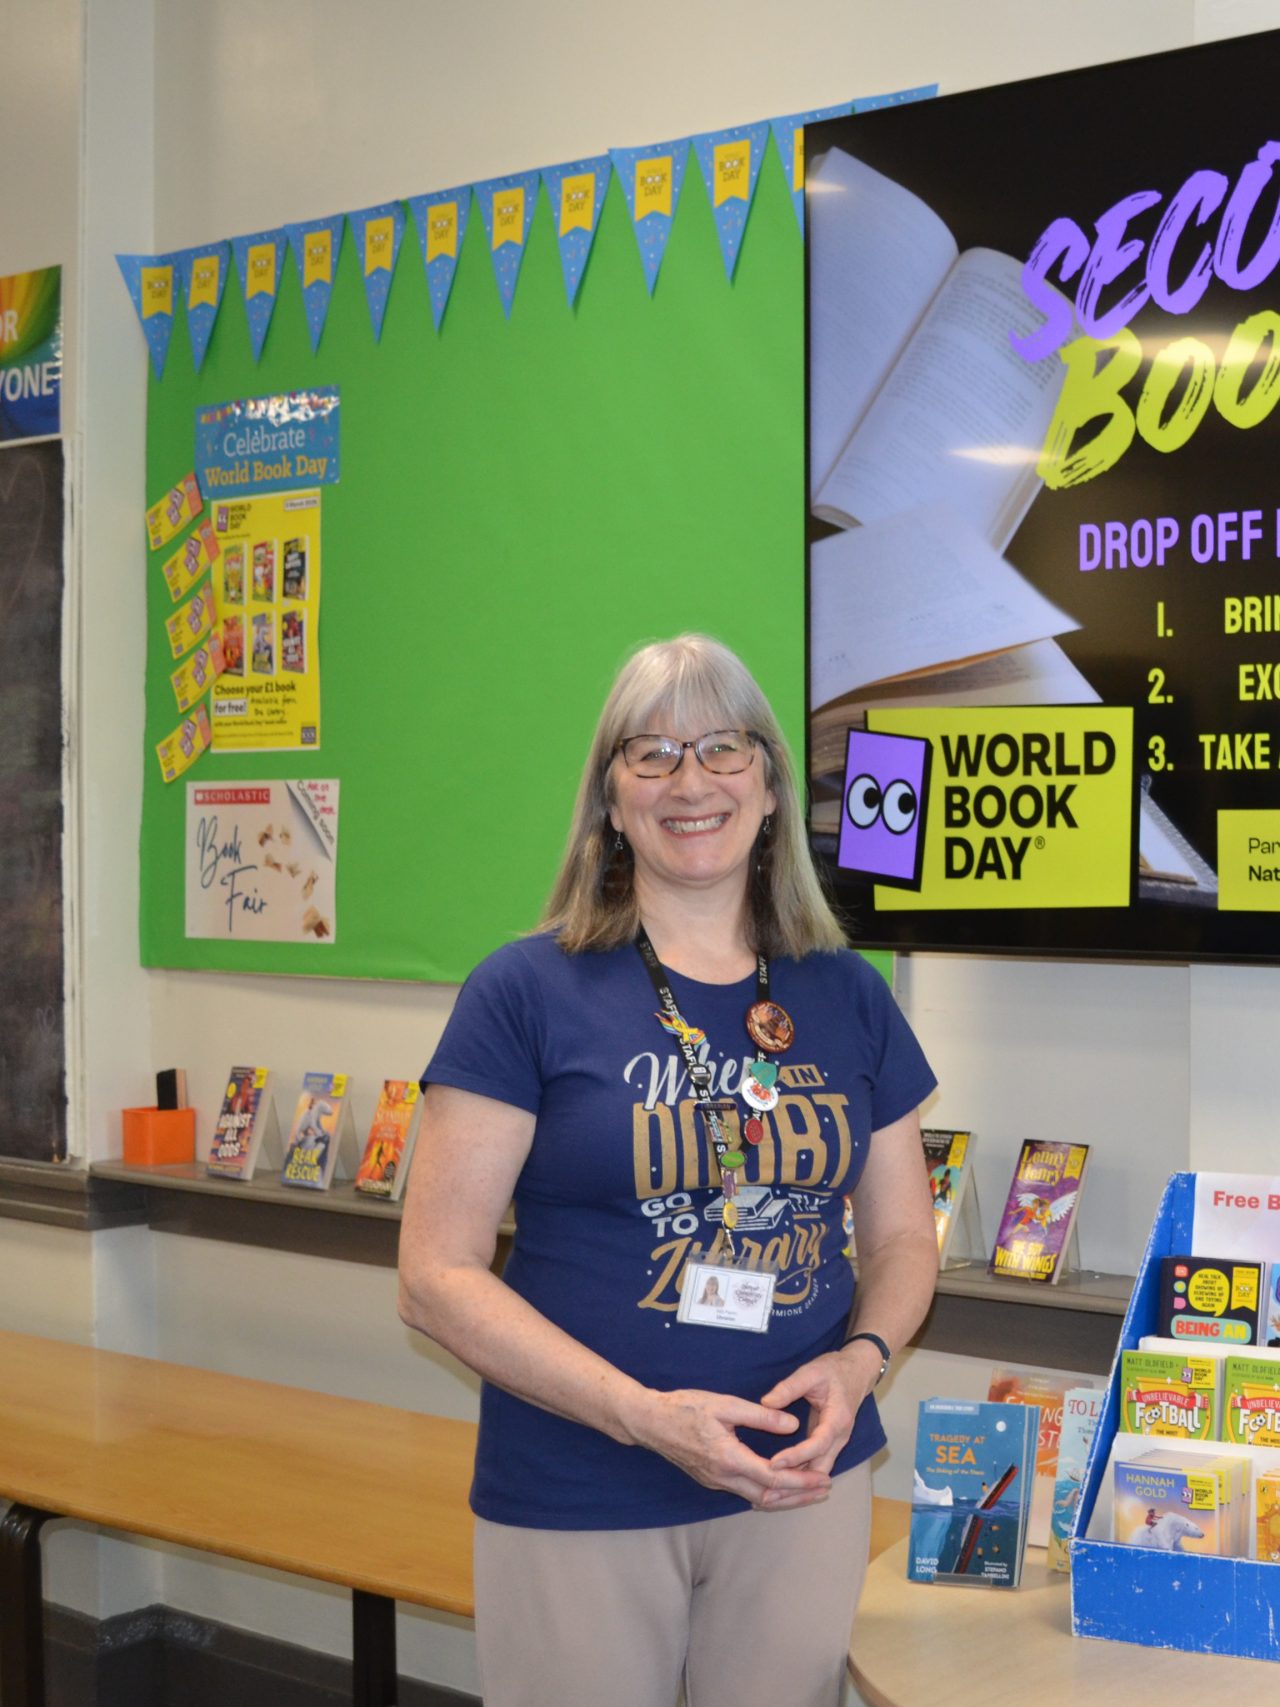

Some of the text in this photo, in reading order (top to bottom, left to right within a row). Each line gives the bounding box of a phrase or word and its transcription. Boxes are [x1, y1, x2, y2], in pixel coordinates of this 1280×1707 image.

[224, 425, 305, 457] Celebrate
[206, 454, 327, 486] World Book Day
[1079, 516, 1180, 572] DROP
[1191, 510, 1264, 563] OFF
[215, 685, 244, 695] Choose
[246, 686, 263, 697] your
[276, 681, 296, 692] book
[1148, 669, 1173, 704] 2.
[215, 702, 247, 712] for free!
[941, 731, 1116, 777] WORLD
[1148, 737, 1173, 772] 3.
[1199, 732, 1270, 771] TAKE
[204, 791, 270, 802] SCHOLASTIC
[945, 784, 1078, 828] BOOK
[319, 818, 335, 846] soon
[197, 816, 242, 889] Book
[221, 865, 267, 932] Fair
[759, 955, 767, 984] STAFF
[788, 1068, 818, 1085] IN
[1021, 1146, 1065, 1166] Lenny
[641, 1192, 692, 1218] GO
[1213, 1191, 1260, 1209] Free
[652, 1213, 699, 1238] TO
[1022, 1254, 1058, 1274] WINGS
[1175, 1320, 1247, 1340] BEING AN
[1145, 1360, 1173, 1368] OLDFIELD
[1068, 1400, 1087, 1416] TO
[1142, 1392, 1190, 1406] UNBELIEVABLE
[930, 1433, 986, 1444] TRAGEDY AT
[936, 1445, 977, 1465] SEA
[1126, 1473, 1175, 1488] HANNAH
[1135, 1486, 1167, 1498] GOLD
[916, 1557, 939, 1566] DAVID
[916, 1566, 937, 1574] LONG
